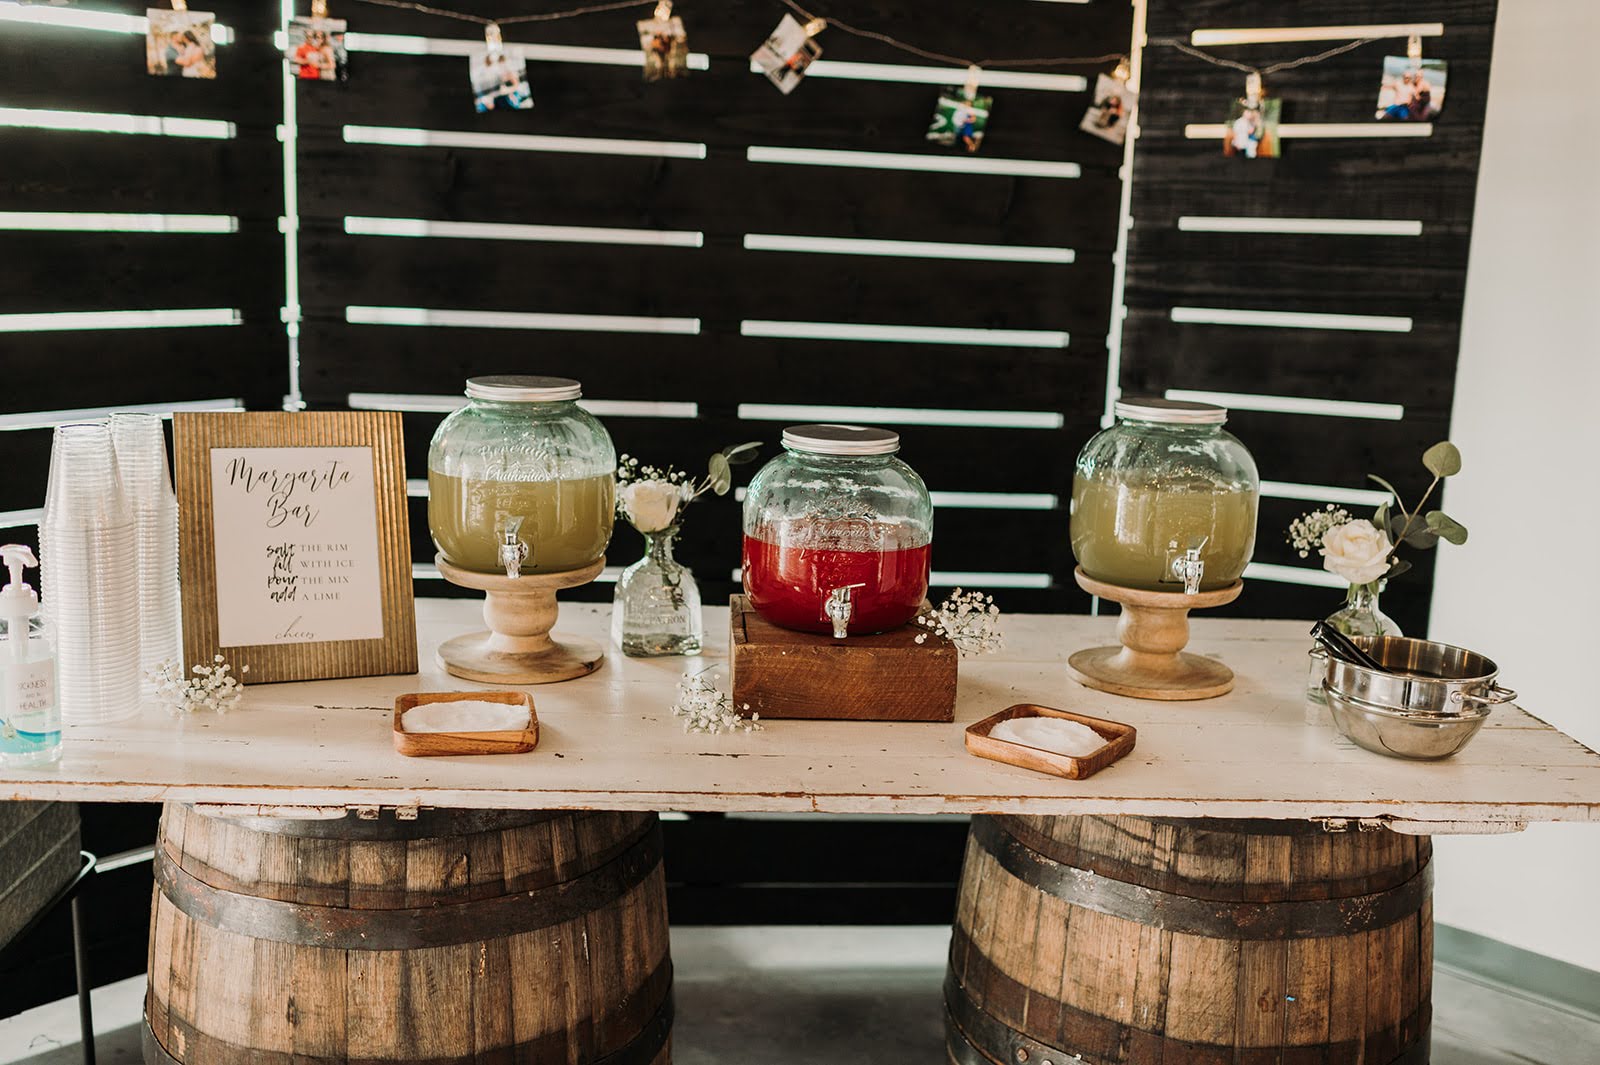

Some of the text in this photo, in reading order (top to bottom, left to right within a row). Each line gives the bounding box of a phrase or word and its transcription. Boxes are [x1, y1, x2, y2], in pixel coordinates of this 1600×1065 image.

[226, 456, 353, 498] Margarita
[266, 491, 320, 528] Bar
[266, 542, 348, 558] salt THE RIM
[273, 555, 355, 578] fill WITH ICE
[267, 575, 350, 588] pour THE MIX
[270, 585, 297, 603] add
[313, 592, 341, 601] LIME
